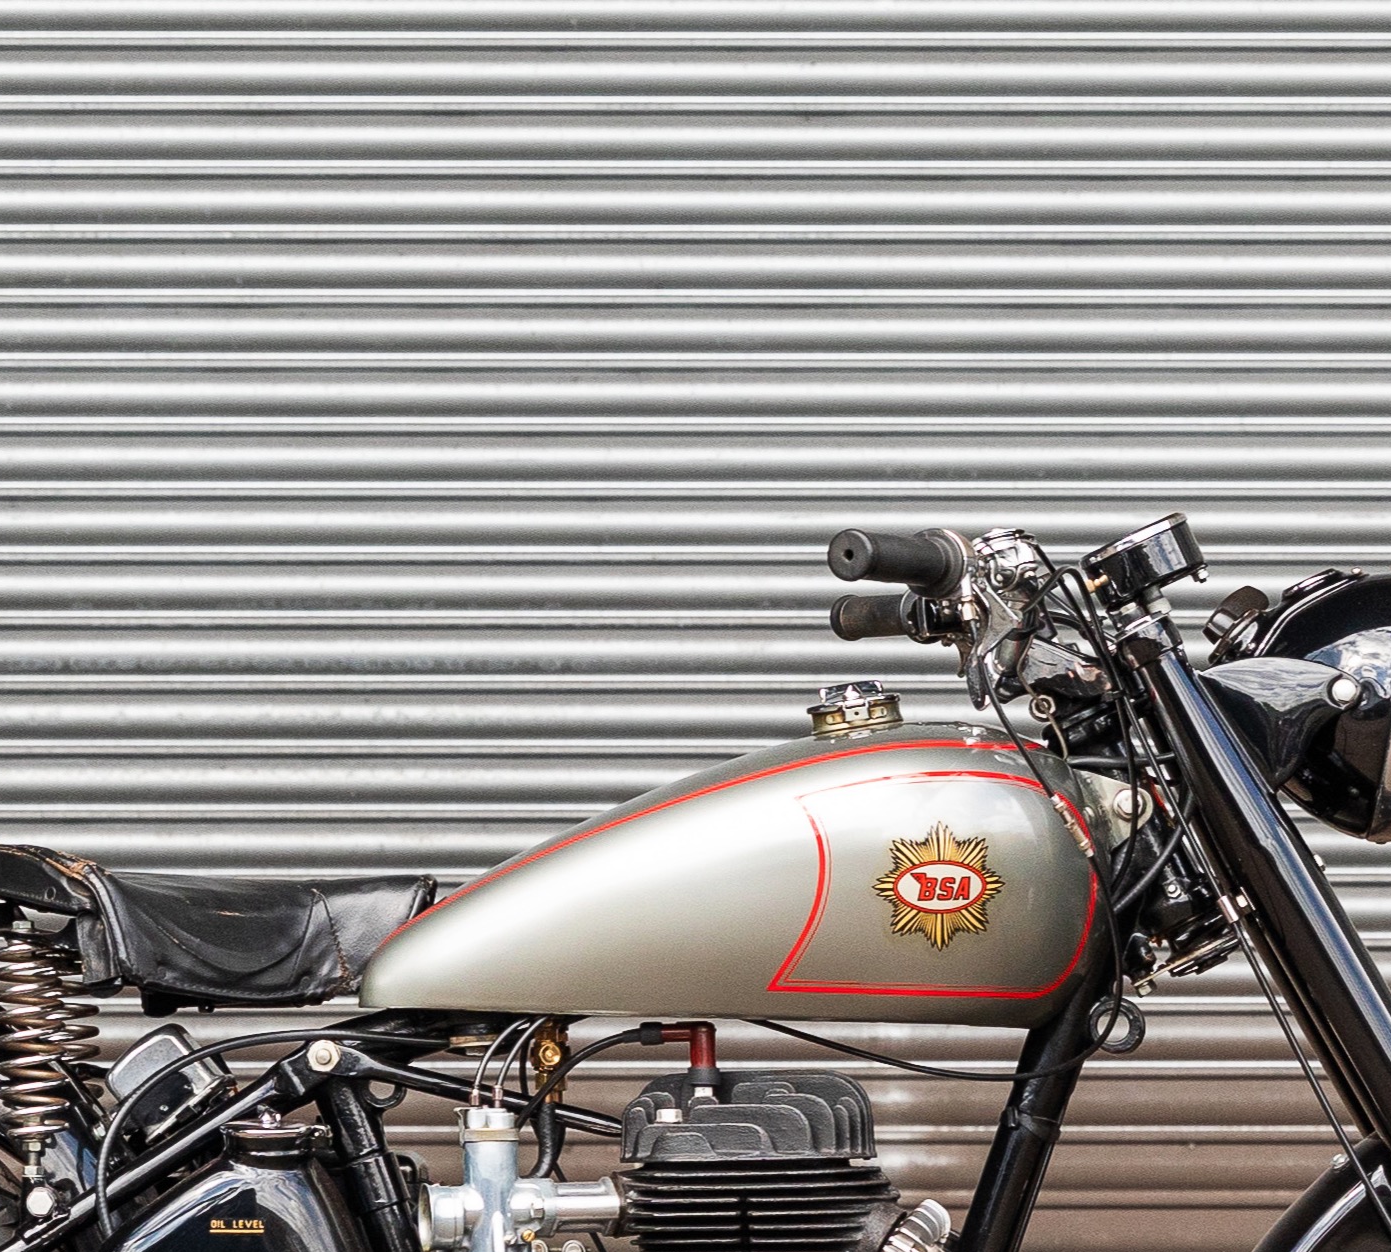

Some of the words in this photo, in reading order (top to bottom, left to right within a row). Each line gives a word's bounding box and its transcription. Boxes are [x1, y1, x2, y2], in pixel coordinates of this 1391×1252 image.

[910, 872, 971, 901] BSA
[210, 1219, 226, 1229] OIL
[232, 1219, 265, 1229] LEVEL
